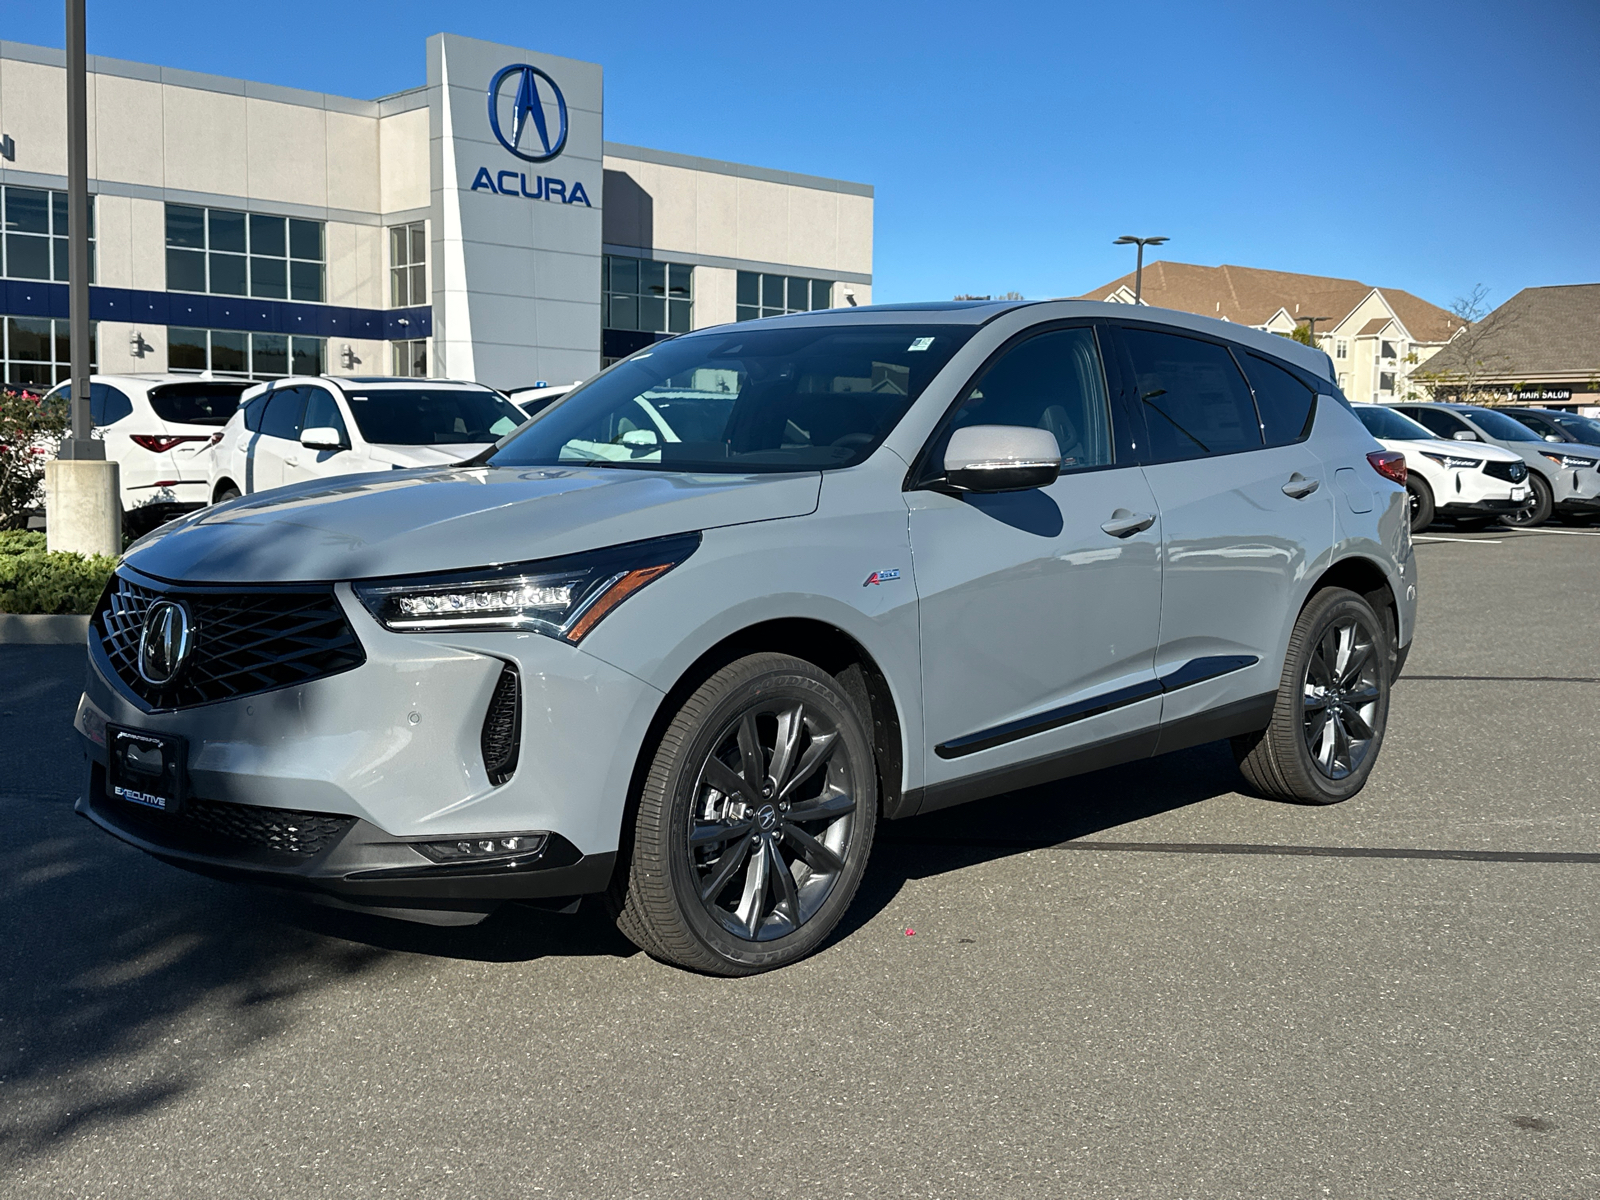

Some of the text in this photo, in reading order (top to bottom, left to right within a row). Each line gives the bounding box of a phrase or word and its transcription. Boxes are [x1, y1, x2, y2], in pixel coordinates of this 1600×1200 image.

[470, 166, 592, 207] ACURA
[1519, 391, 1540, 400] HAIR
[1541, 389, 1570, 399] SALON
[748, 675, 847, 713] GOODYEAR
[114, 785, 166, 807] EXECUTIVE
